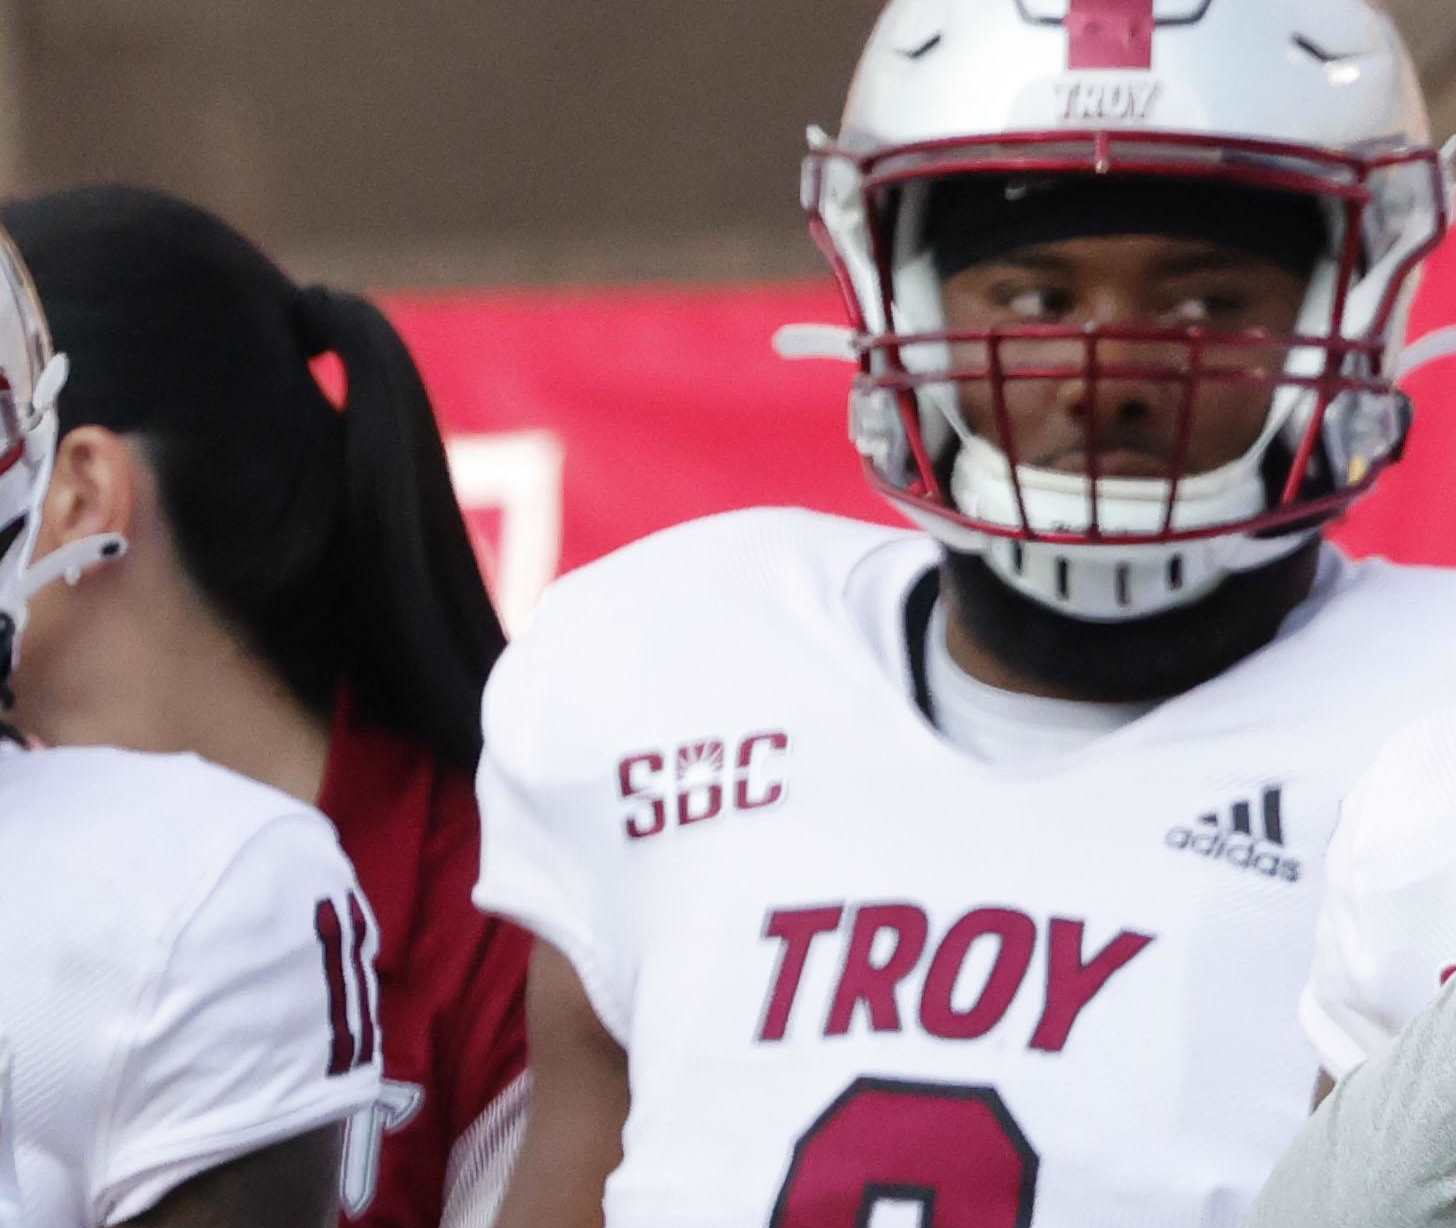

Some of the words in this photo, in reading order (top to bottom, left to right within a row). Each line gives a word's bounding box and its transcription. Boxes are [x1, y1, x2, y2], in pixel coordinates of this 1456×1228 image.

[617, 731, 790, 842] SBC
[1163, 822, 1303, 884] adidas
[313, 888, 376, 1077] 11
[752, 899, 1157, 1053] TROY
